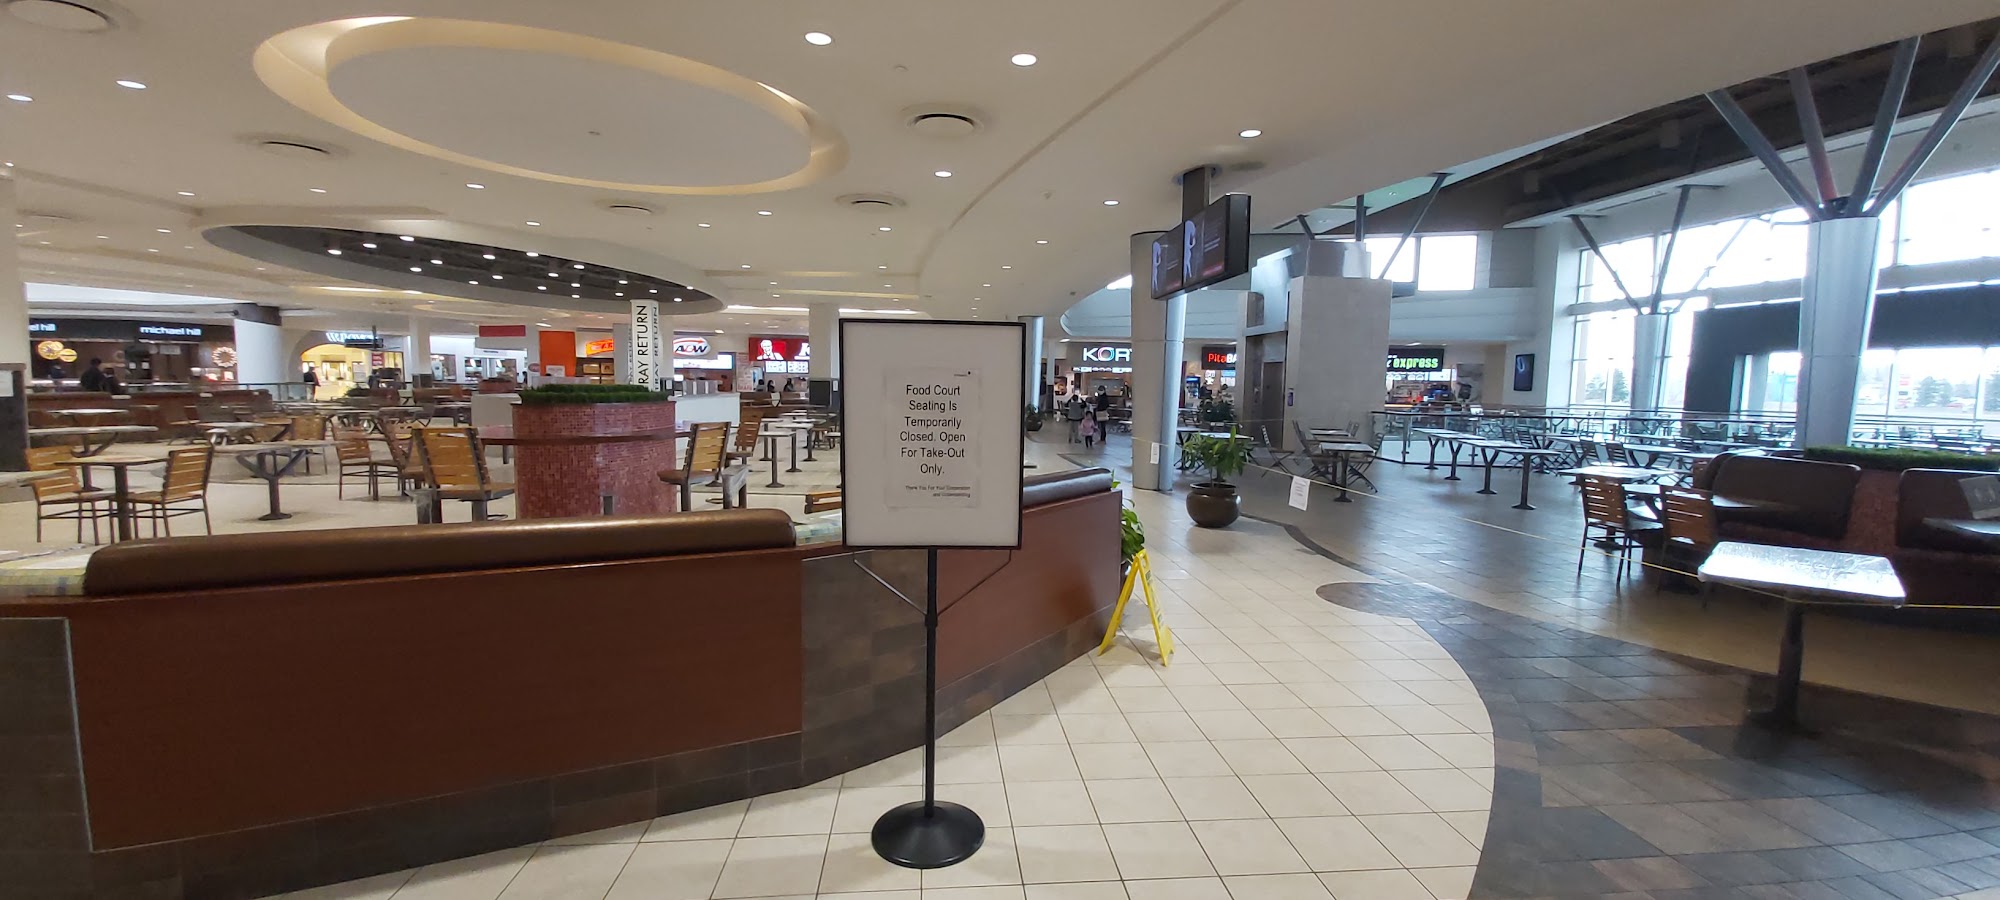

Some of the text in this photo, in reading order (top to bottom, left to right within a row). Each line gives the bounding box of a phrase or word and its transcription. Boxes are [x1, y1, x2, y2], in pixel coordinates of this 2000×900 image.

[140, 326, 202, 336] michael hill
[636, 305, 649, 385] RAY RETURN
[1083, 346, 1133, 362] KOR
[1393, 357, 1439, 369] express
[906, 384, 961, 396] Food Court
[909, 399, 958, 414] Seating Is
[904, 416, 962, 430] Temporarily
[900, 430, 966, 444] Closed. Open
[901, 447, 965, 458] For Take-Out
[920, 463, 945, 476] Only.
